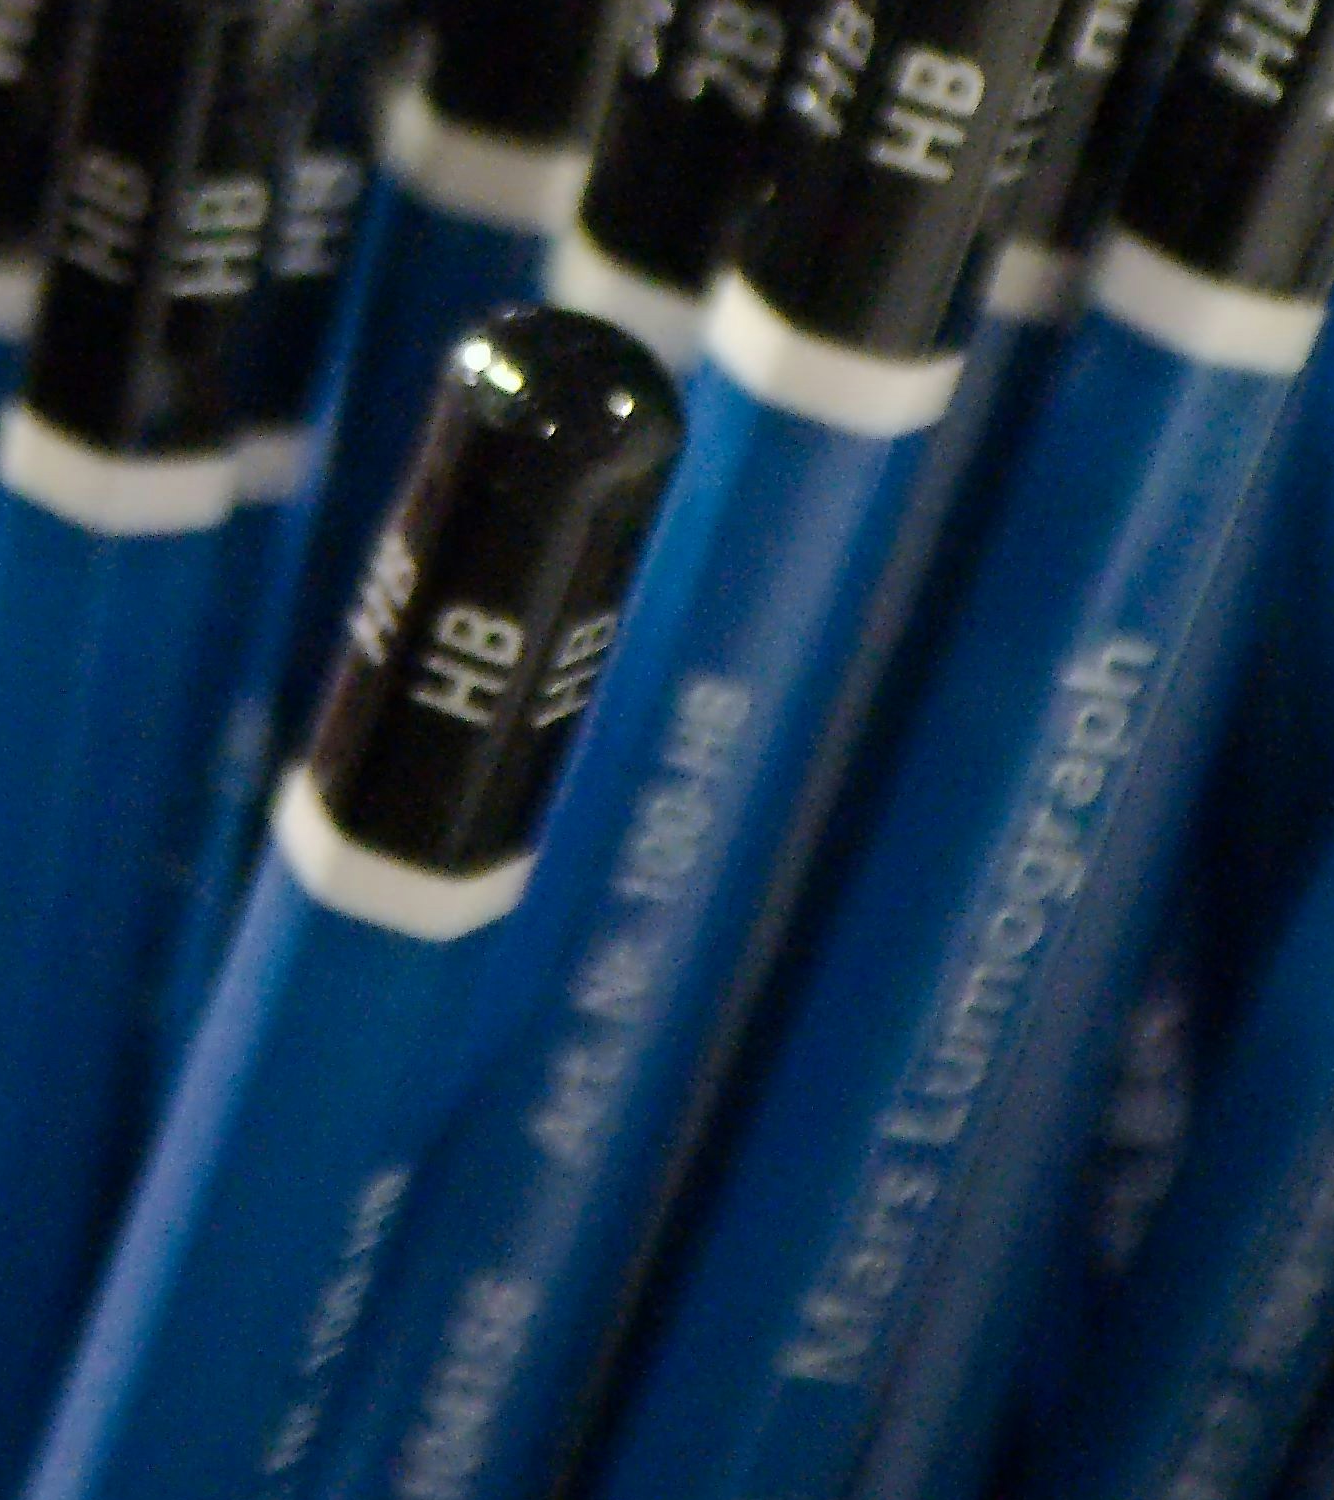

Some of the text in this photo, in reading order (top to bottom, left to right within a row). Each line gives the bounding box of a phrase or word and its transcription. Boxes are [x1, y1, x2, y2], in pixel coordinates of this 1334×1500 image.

[869, 42, 988, 184] HB
[162, 172, 267, 300] HB
[409, 602, 525, 728] HB
[529, 611, 618, 731] HB
[769, 1153, 941, 1386] Mars
[872, 630, 1157, 1150] Lumograph
